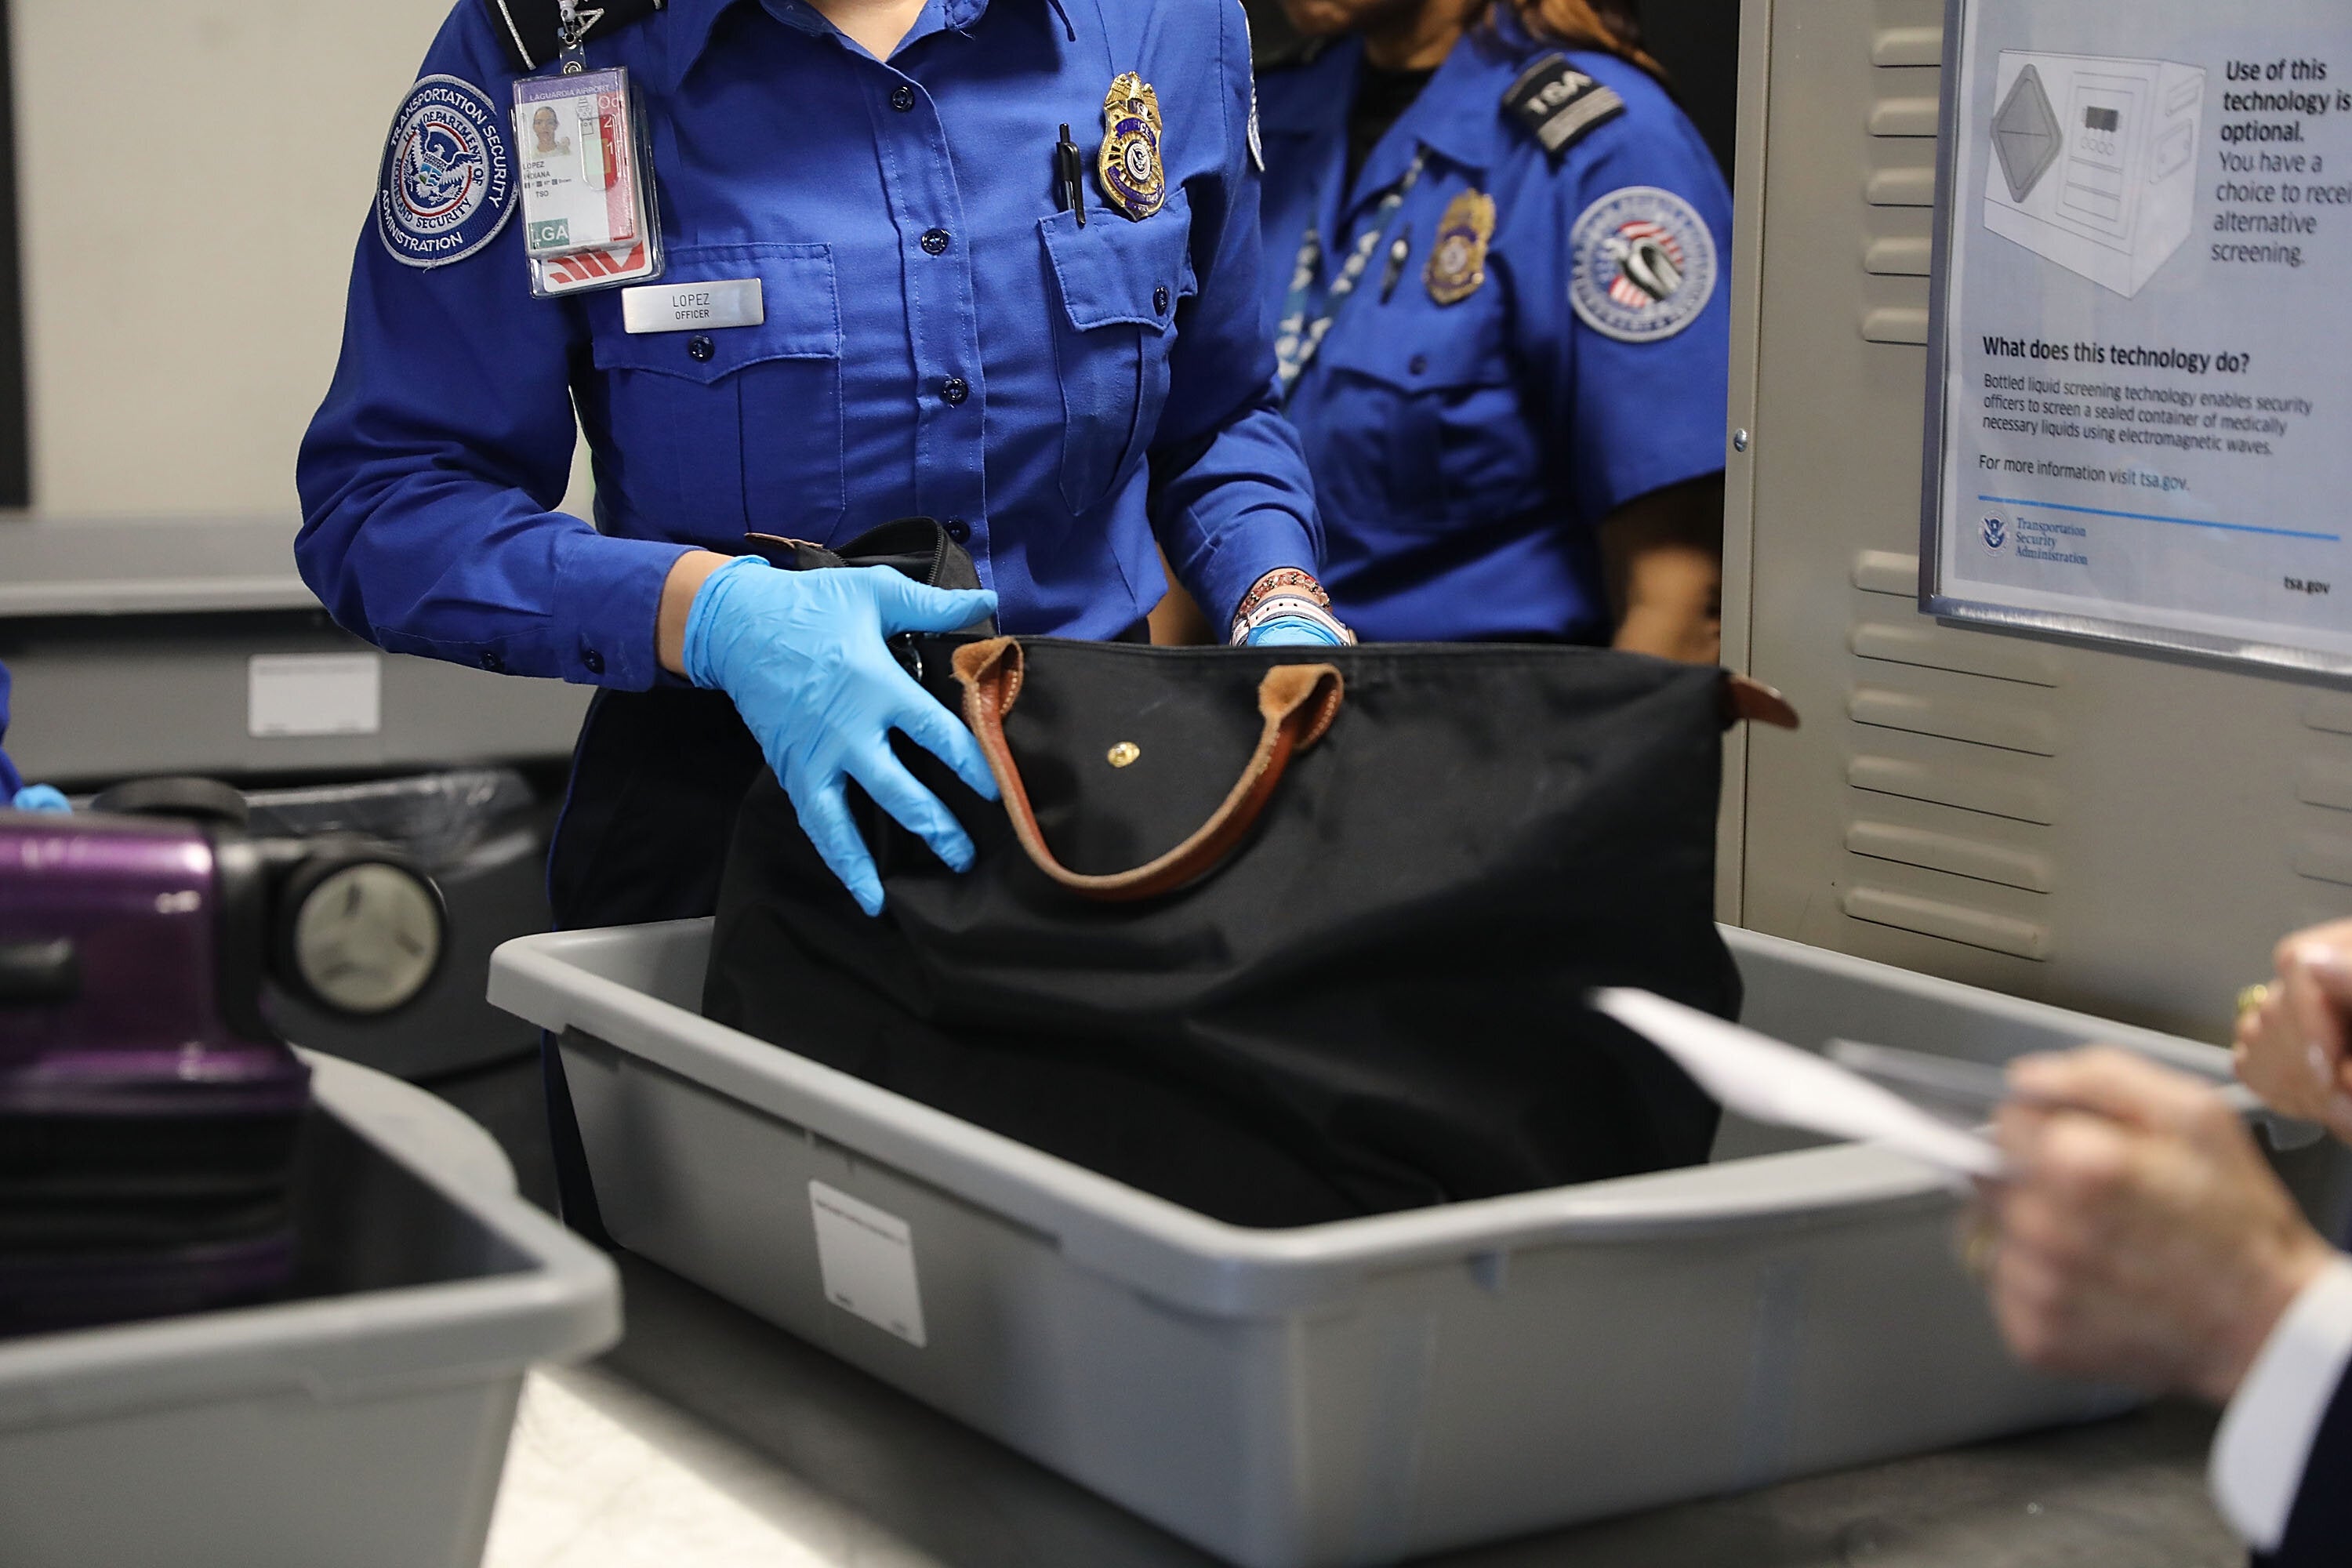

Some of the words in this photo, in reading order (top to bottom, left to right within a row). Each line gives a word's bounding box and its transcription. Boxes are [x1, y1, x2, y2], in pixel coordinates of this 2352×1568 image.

[2227, 60, 2260, 81] Use
[2266, 59, 2286, 81] of
[2291, 58, 2327, 81] this
[529, 89, 575, 101] LAGUARDIA
[576, 84, 611, 95] AIRPORT
[2223, 89, 2331, 114] technology
[2336, 89, 2352, 111] is
[423, 111, 483, 165] DEPARTMENT
[2221, 120, 2303, 144] optional.
[391, 89, 488, 146] TRANSPORTATION
[482, 125, 506, 209] SECURITY
[2220, 151, 2254, 172] You
[2260, 151, 2306, 172] have
[2311, 155, 2323, 172] a
[2216, 180, 2276, 202] choice
[2281, 183, 2300, 203] to
[383, 189, 464, 252] ADMINISTRATION
[416, 198, 471, 229] SECURITY
[2213, 211, 2318, 234] alternative
[2211, 241, 2305, 267] screening.
[672, 292, 710, 307] LOPEZ
[675, 310, 710, 320] OFFICER
[1983, 336, 2026, 358] What
[2030, 339, 2070, 361] does
[2074, 342, 2105, 363] this
[2111, 345, 2211, 374] technology
[2216, 351, 2250, 373] do?
[1984, 373, 2025, 390] Bottled
[2028, 376, 2060, 394] liquid
[2063, 381, 2122, 401] screening
[2125, 386, 2196, 407] technology
[2200, 393, 2252, 409] enables
[2256, 396, 2313, 416] security
[1984, 394, 2025, 412] officers
[2028, 398, 2039, 412] to
[2042, 401, 2080, 417] screen
[2084, 405, 2091, 417] a
[2095, 405, 2135, 422] sealed
[2138, 408, 2198, 426] container
[2203, 412, 2217, 428] of
[2221, 416, 2288, 437] medically
[1983, 416, 2038, 435] necessary
[2042, 419, 2080, 437] liquids
[2083, 423, 2115, 443] using
[2119, 427, 2222, 450] electromagnetic
[1979, 455, 2000, 470] For
[2004, 458, 2034, 474] more
[2038, 459, 2106, 482] information
[2111, 468, 2136, 486] visit
[2140, 472, 2190, 492] tsa.gov.
[2016, 517, 2087, 537] Transportation
[2016, 532, 2057, 549] Security
[2016, 546, 2089, 565] Administration
